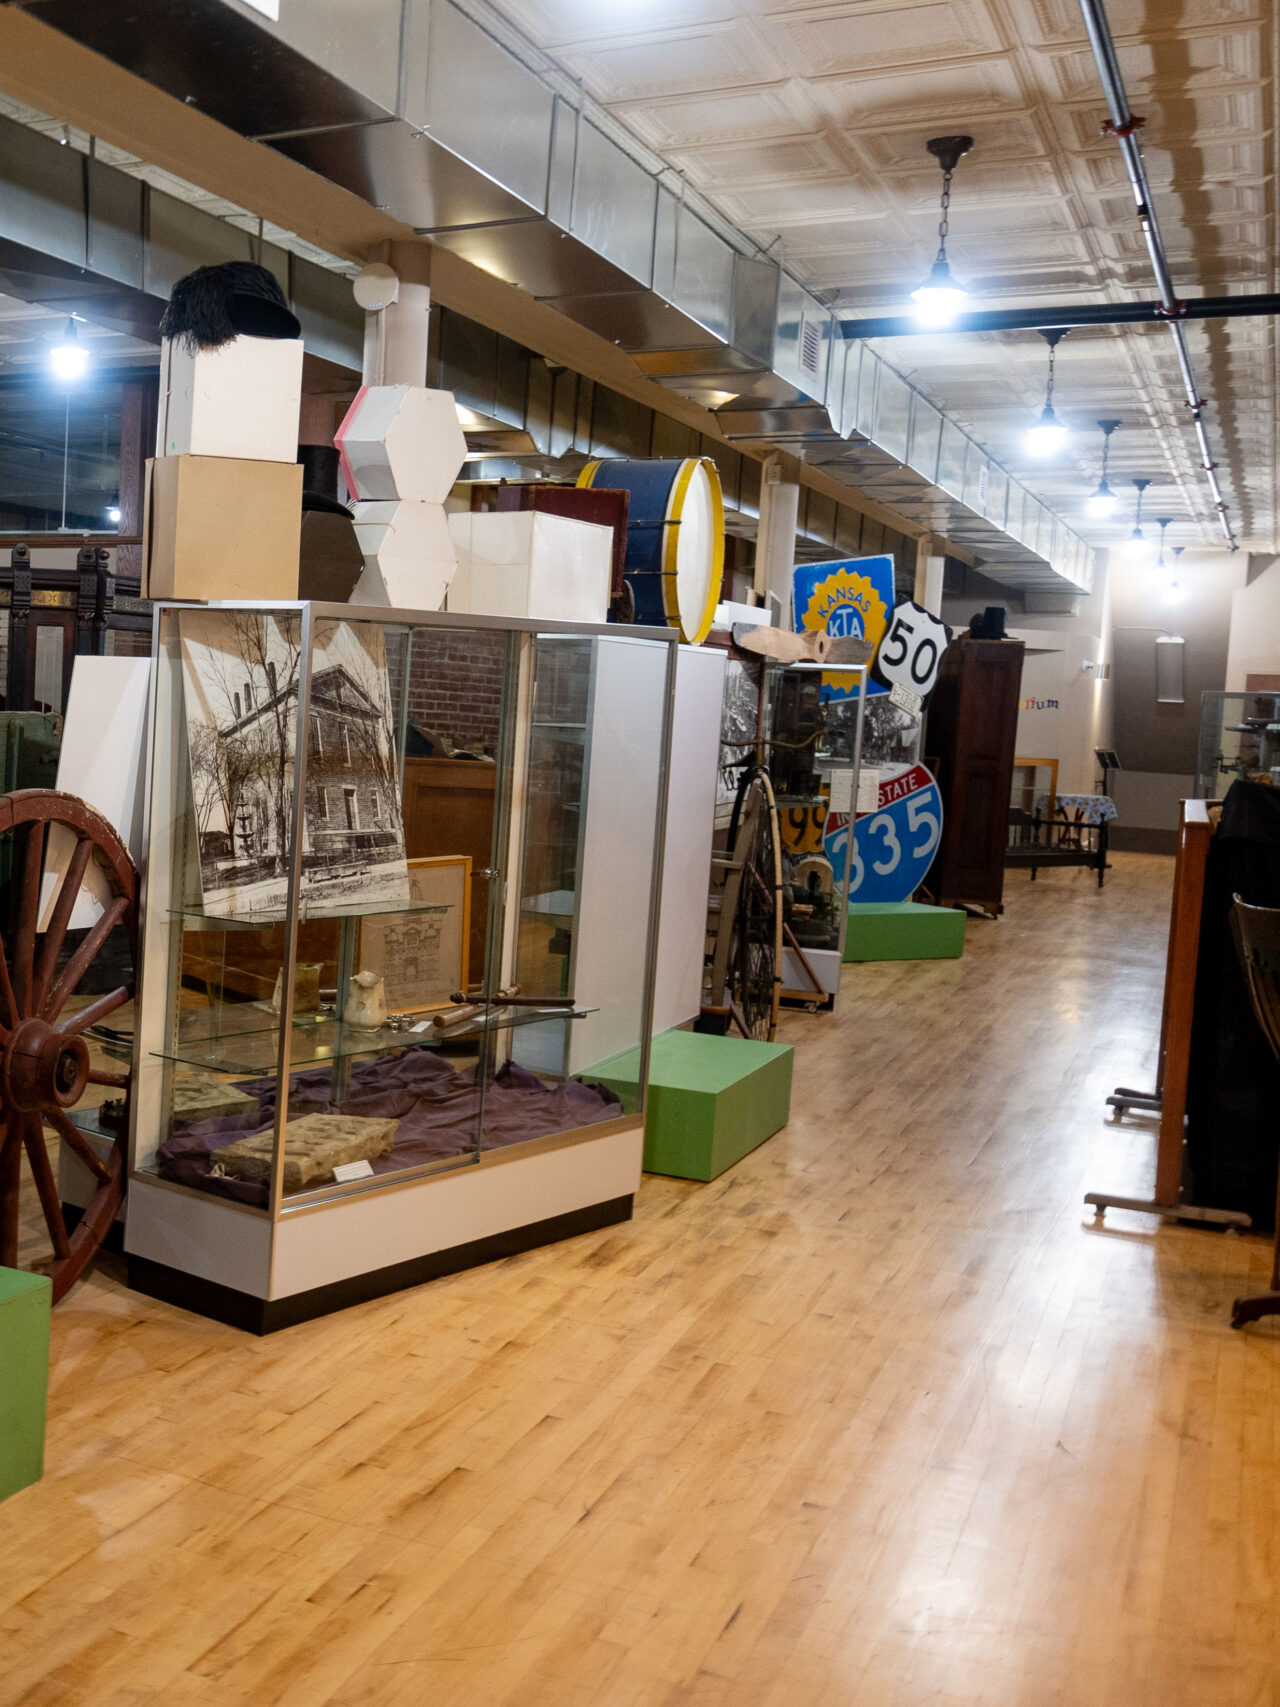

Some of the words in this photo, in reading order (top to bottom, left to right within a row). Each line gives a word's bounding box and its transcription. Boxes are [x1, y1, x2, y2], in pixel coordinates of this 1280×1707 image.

[817, 586, 872, 619] KANSAS
[828, 607, 863, 641] KTA
[882, 617, 938, 685] 50
[837, 773, 918, 826] INSTATE
[832, 791, 939, 894] 335
